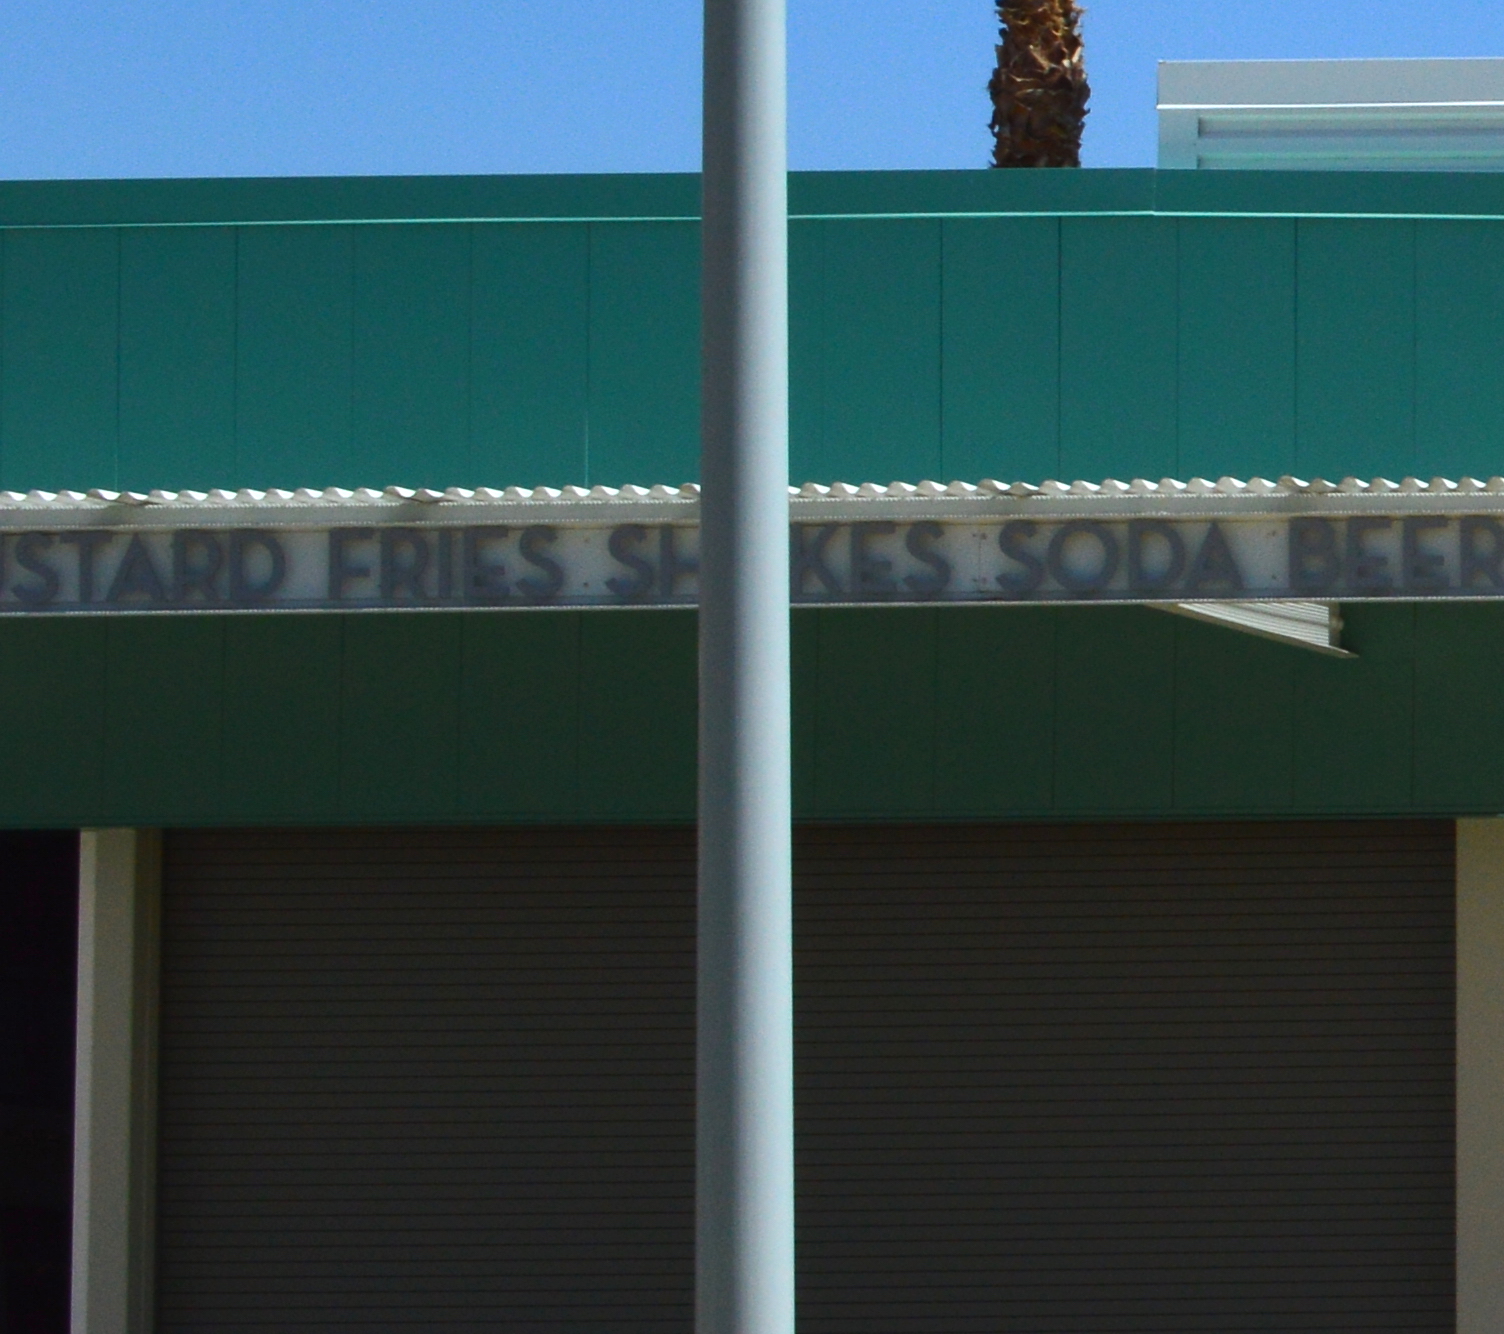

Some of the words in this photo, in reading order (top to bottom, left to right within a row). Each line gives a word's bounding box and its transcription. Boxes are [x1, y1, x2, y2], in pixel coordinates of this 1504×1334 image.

[0, 528, 286, 605] STARD
[328, 524, 564, 600] FRIES
[604, 519, 954, 599] SHKES
[996, 517, 1245, 595] SODA
